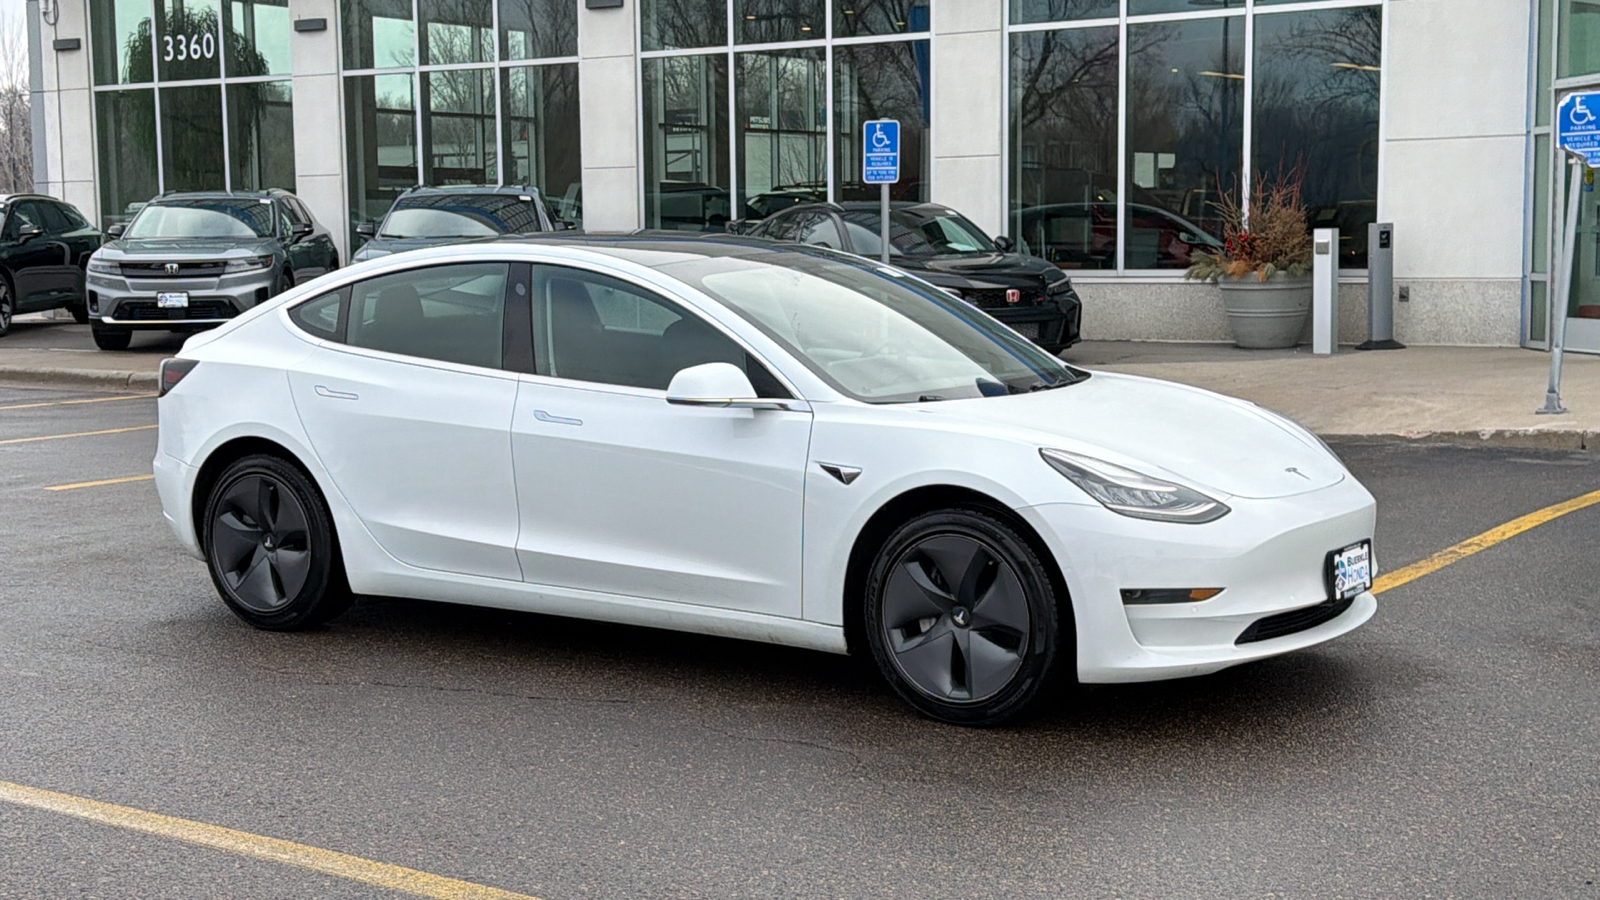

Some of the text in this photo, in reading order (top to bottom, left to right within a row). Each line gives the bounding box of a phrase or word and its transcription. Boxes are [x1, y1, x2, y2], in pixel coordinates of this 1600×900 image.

[163, 32, 215, 62] 3360
[1566, 134, 1591, 142] VEHICLE
[1347, 552, 1368, 567] BUERKLE
[1348, 565, 1369, 585] HONDA
